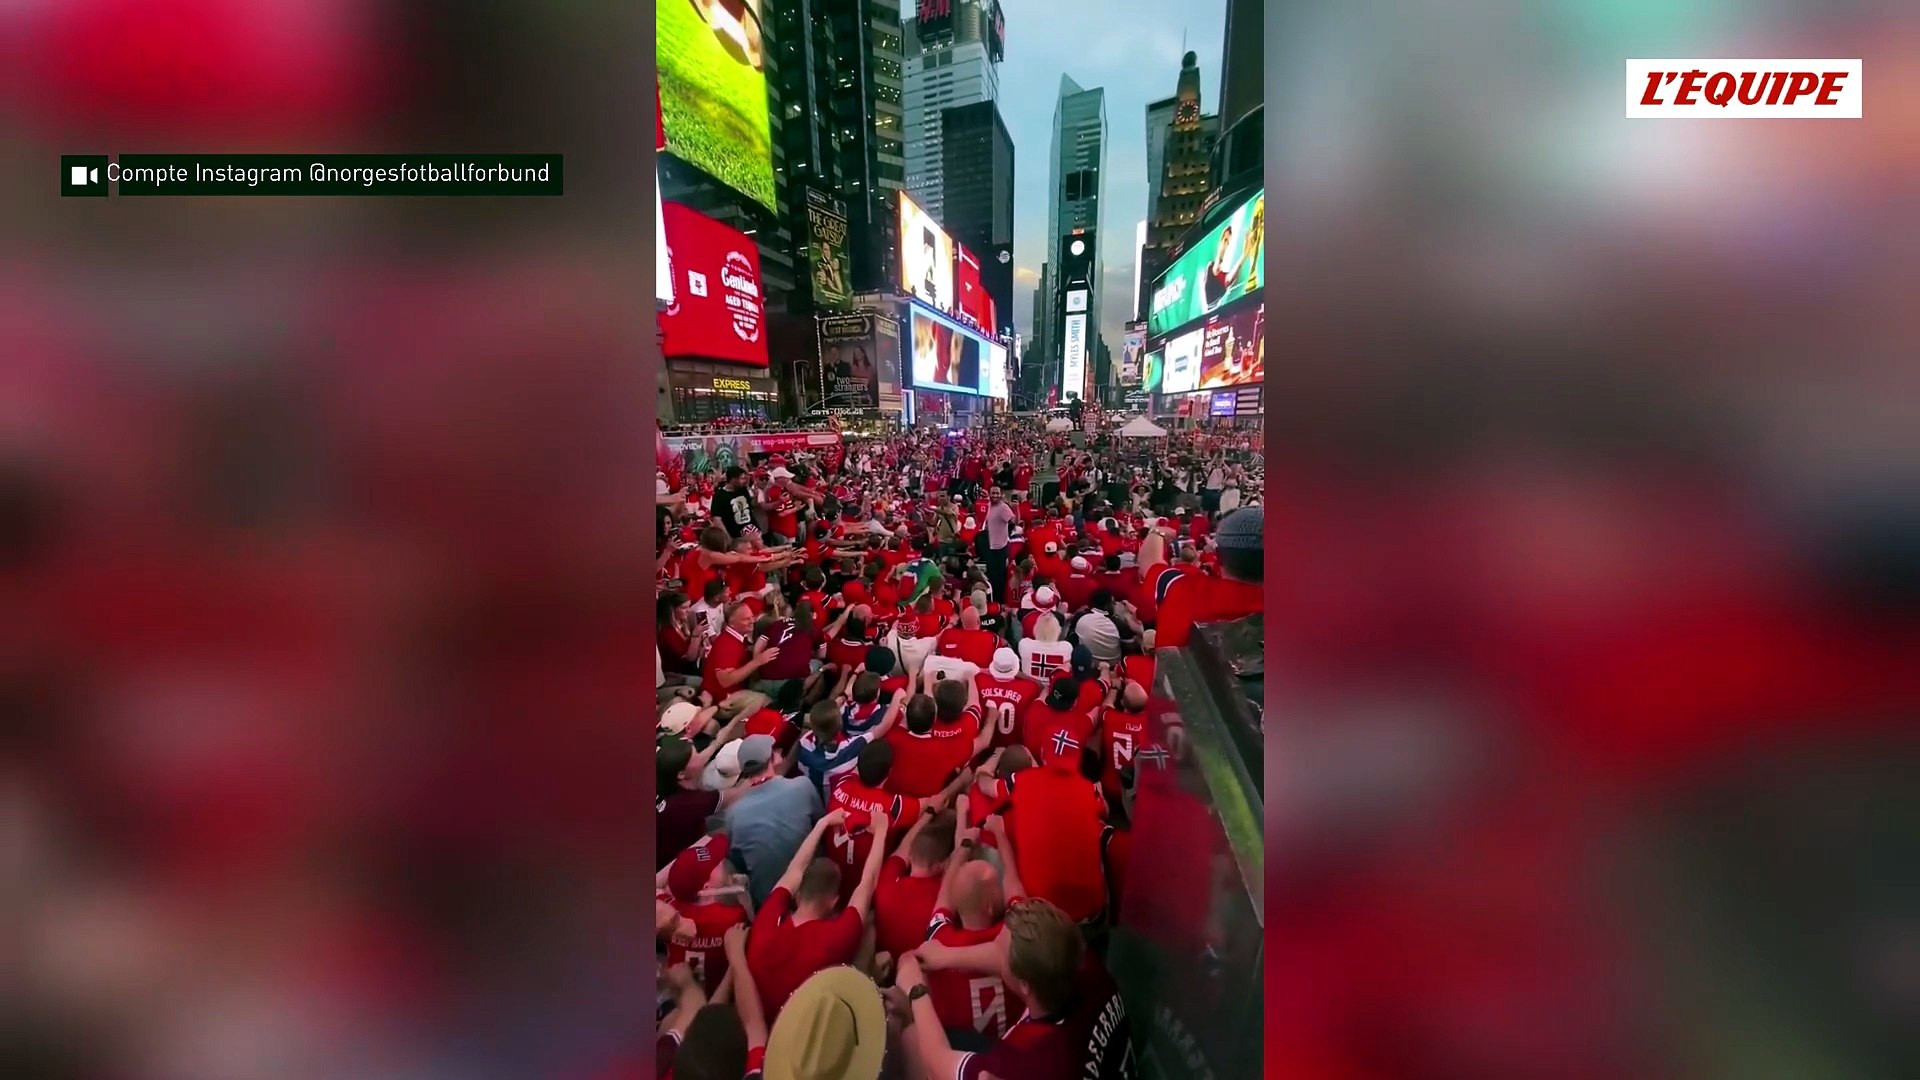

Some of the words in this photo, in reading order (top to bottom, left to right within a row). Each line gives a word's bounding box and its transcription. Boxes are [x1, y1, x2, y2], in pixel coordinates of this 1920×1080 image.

[808, 208, 823, 225] THE
[823, 215, 848, 236] GREAT
[813, 224, 845, 246] GATSBY
[1071, 319, 1081, 343] SMITH
[1070, 343, 1080, 368] MYLES
[713, 378, 751, 391] EXPRESS
[833, 383, 869, 394] strangers
[836, 377, 851, 385] two
[985, 699, 1015, 735] 0
[850, 797, 884, 812] HAALAND
[969, 976, 1006, 1039] 9
